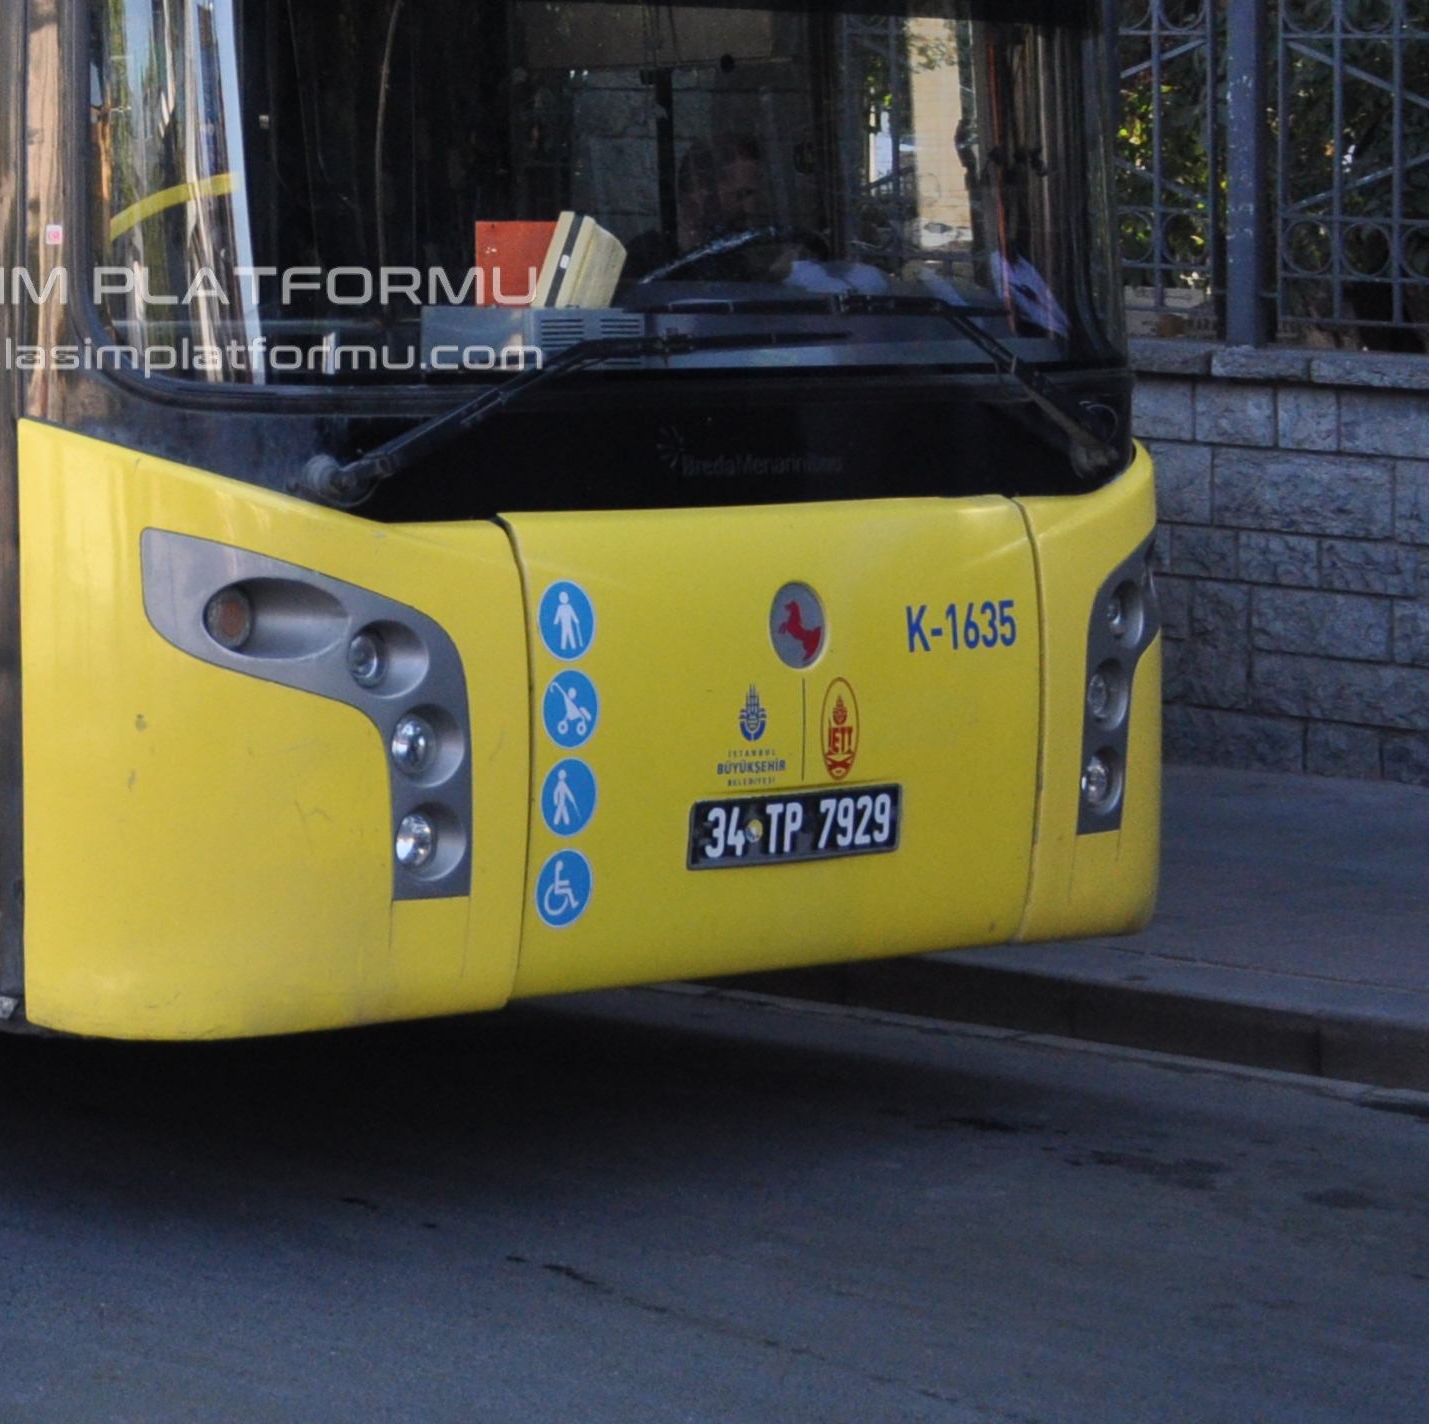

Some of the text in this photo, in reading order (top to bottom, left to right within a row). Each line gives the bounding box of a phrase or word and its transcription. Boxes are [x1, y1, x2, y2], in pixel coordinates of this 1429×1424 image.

[906, 599, 1017, 653] K-1635
[717, 758, 786, 775] BÜYÜKŞEHİR
[705, 793, 891, 858] 34 TP 7929
